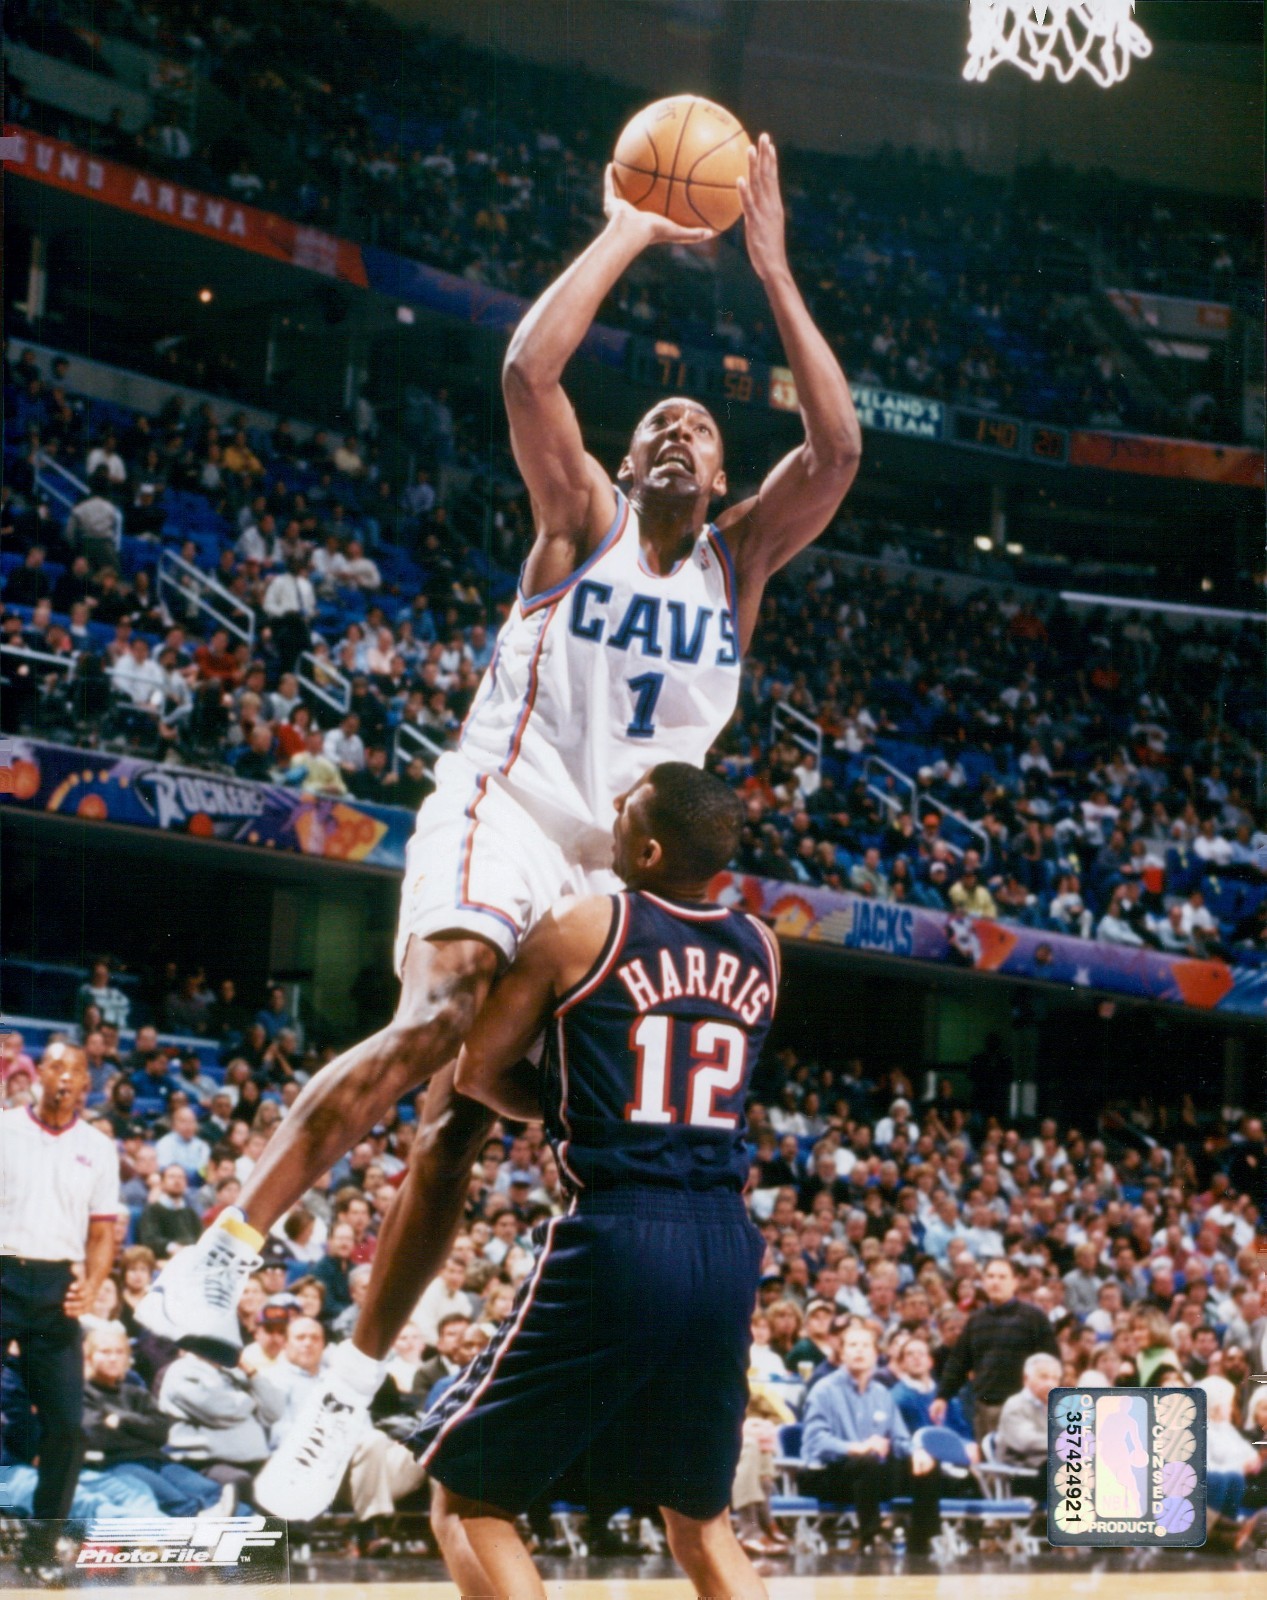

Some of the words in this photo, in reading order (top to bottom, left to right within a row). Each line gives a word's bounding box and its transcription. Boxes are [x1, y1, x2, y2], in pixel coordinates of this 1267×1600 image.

[131, 176, 247, 237] ARENA
[884, 411, 936, 436] TEAM
[569, 579, 738, 666] CAVS
[626, 671, 664, 738] 1
[844, 901, 913, 957] JACKS
[617, 945, 771, 1026] HARRIS
[624, 1014, 747, 1131] 12
